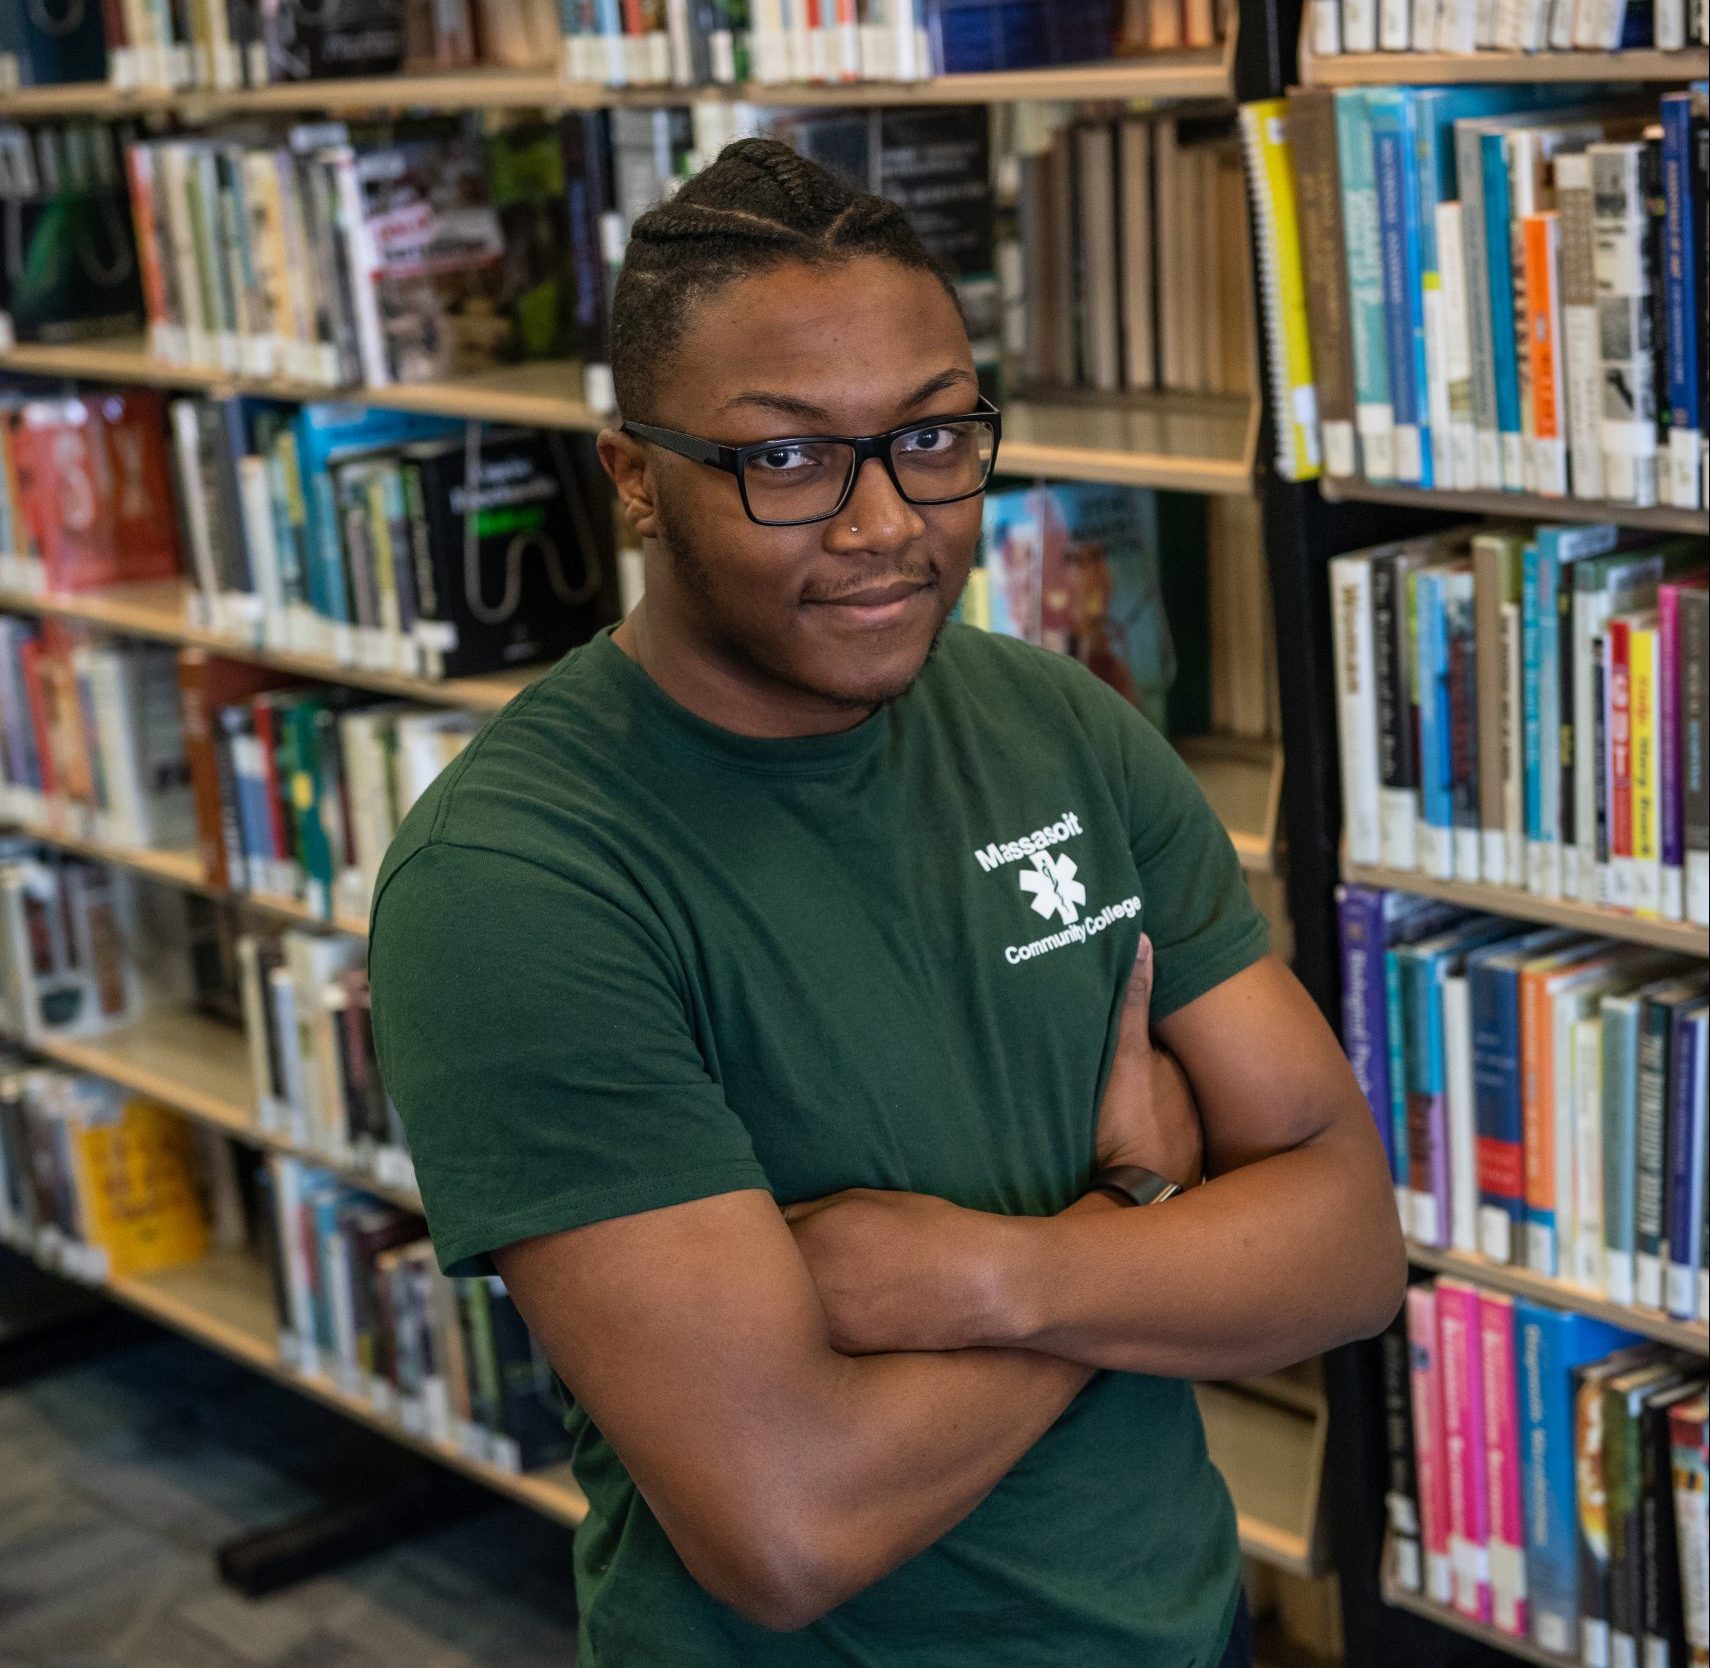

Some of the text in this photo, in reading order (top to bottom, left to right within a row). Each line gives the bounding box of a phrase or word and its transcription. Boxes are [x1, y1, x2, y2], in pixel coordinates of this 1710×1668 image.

[974, 811, 1083, 872] Massasoit
[1004, 896, 1142, 965] Community College
